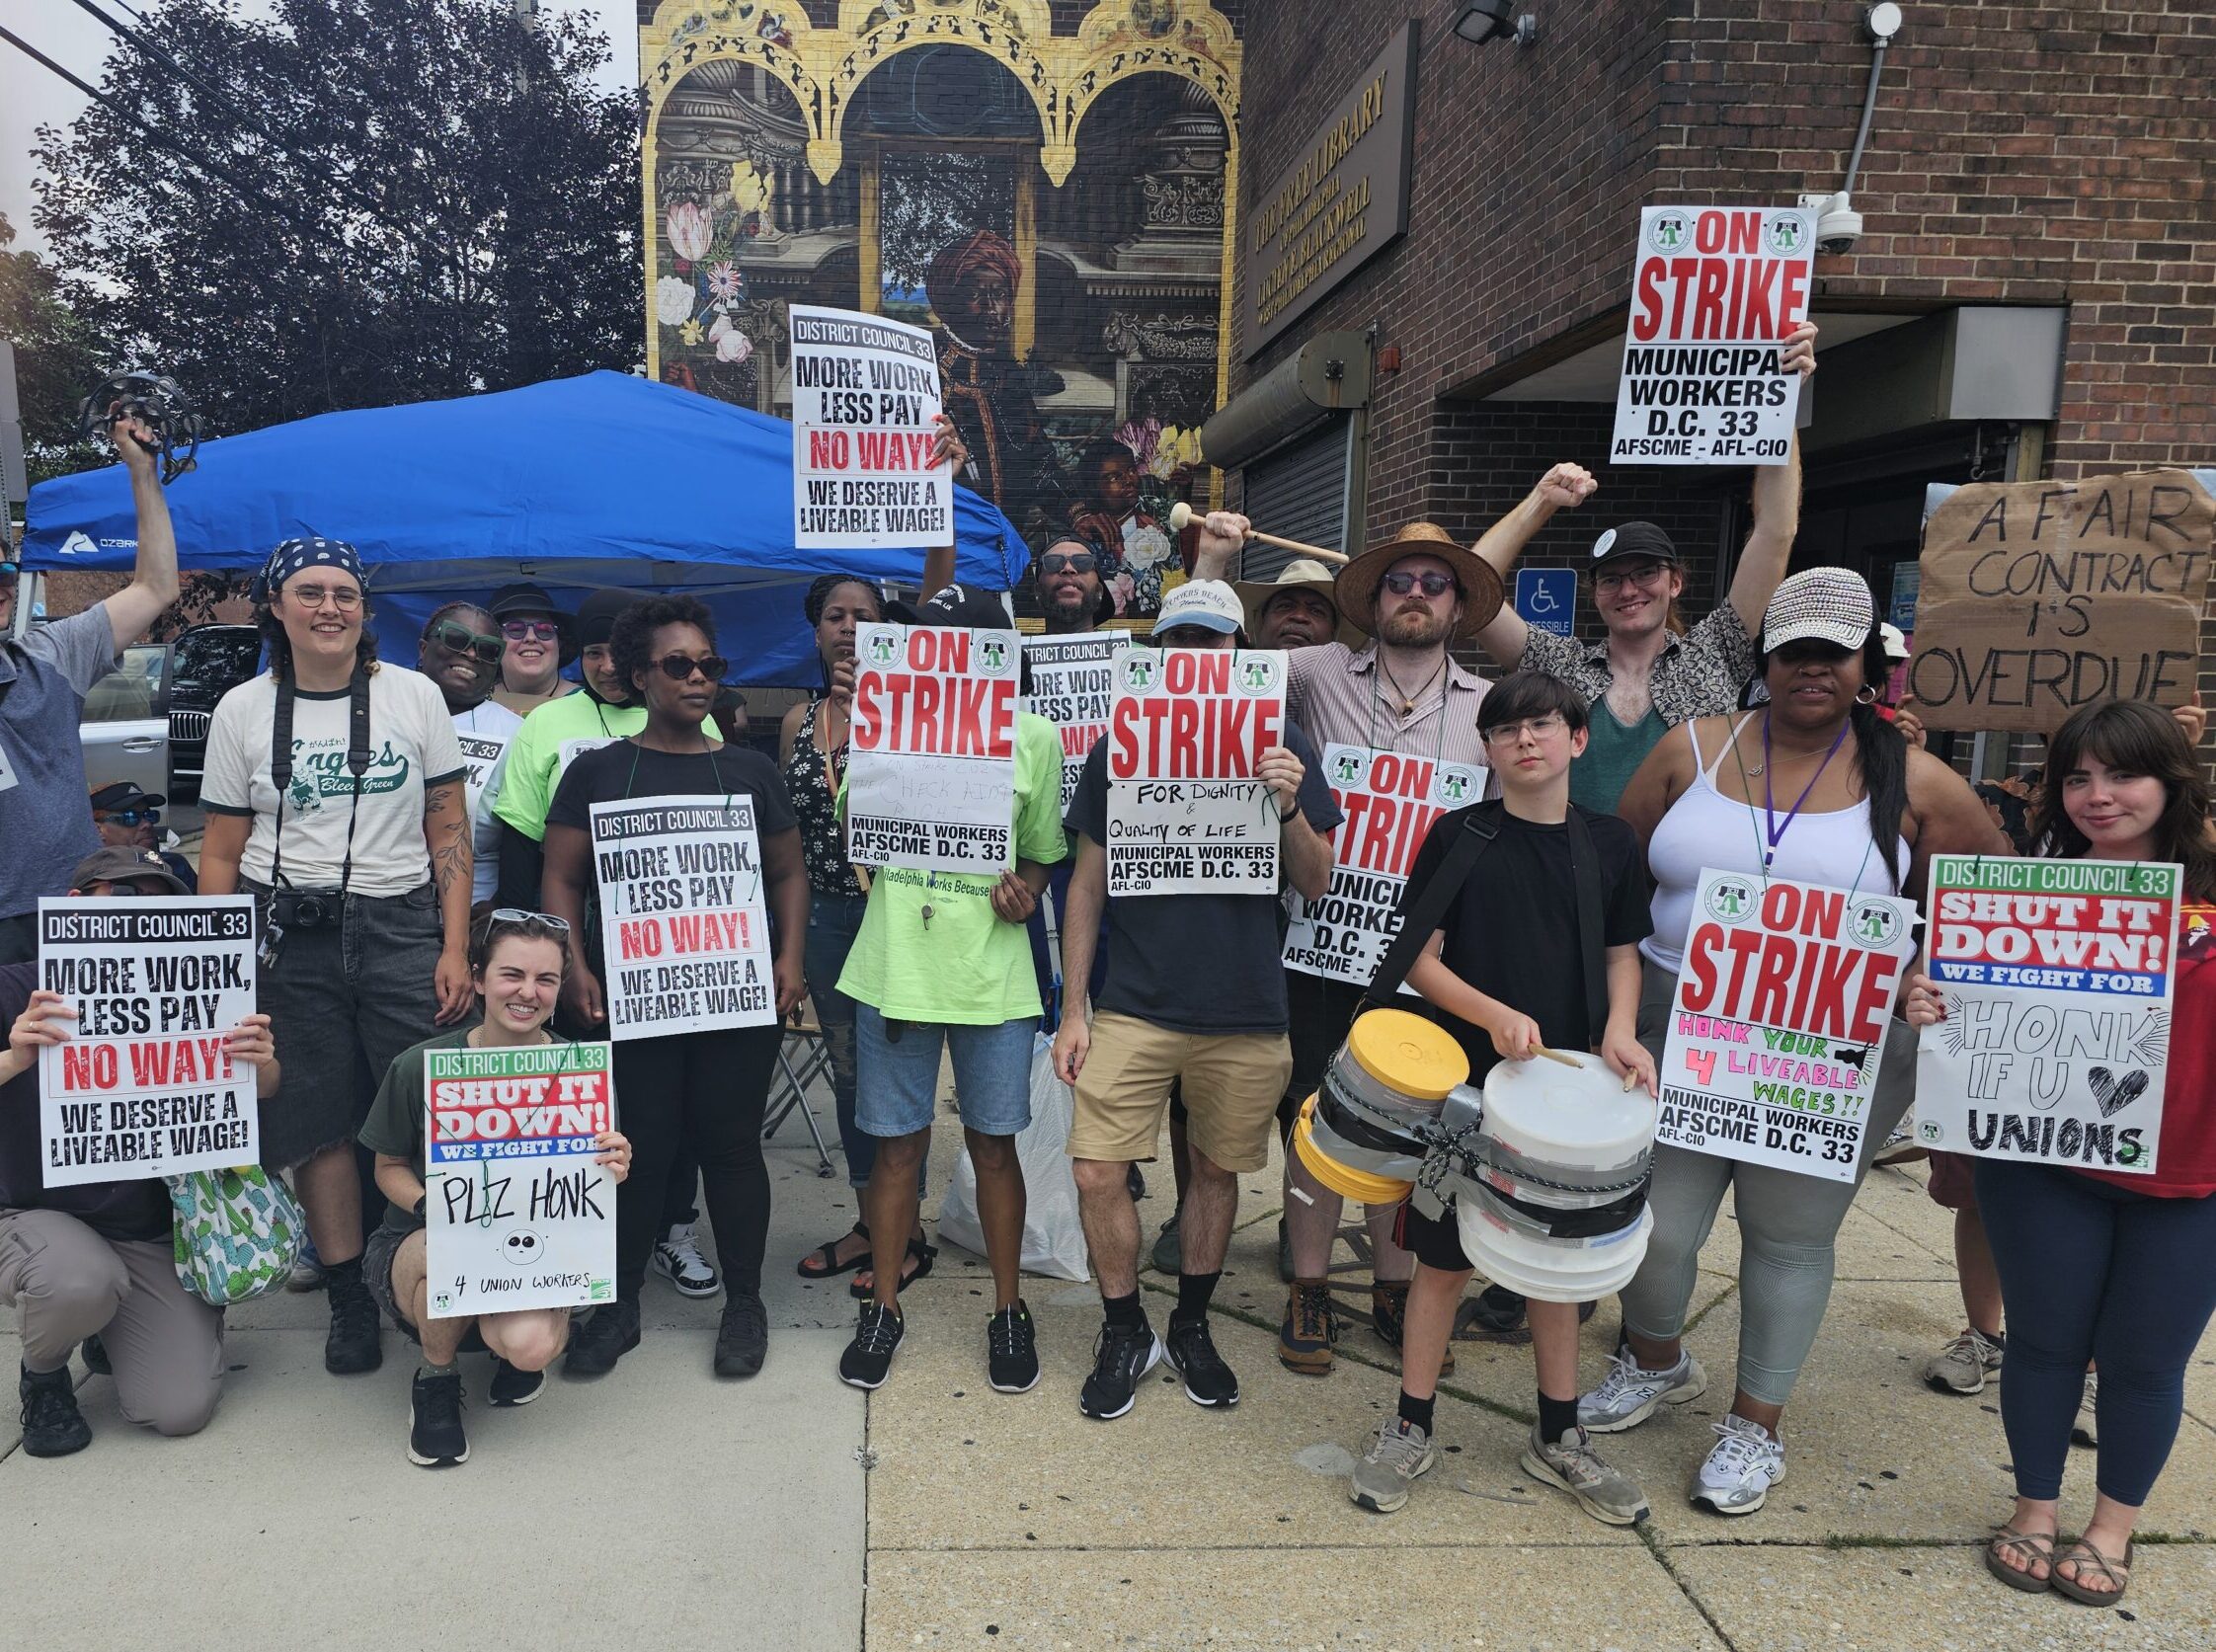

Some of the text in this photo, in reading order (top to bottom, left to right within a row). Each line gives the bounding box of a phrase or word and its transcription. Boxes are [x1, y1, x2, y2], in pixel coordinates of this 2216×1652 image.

[1255, 201, 1278, 253] THE
[1313, 69, 1388, 187] LIBRARY
[1696, 210, 1762, 254] ON
[1633, 257, 1808, 341] STRIKE
[797, 321, 931, 358] DISTRICT COUNCIL 33
[796, 355, 939, 402] MORE WORK,
[1630, 380, 1787, 406] WORKERS
[821, 392, 922, 425] LESS PAY
[1648, 410, 1759, 436] D.C. 33
[810, 431, 848, 469] NO
[1615, 439, 1787, 456] AFSCME AFL-CIO
[808, 480, 937, 506] WE DESERVE A
[801, 508, 944, 533] LIVEABLE WAGE!
[1968, 486, 2193, 543] A FAIR
[1968, 550, 2207, 597] CONTRACT
[2027, 594, 2093, 637] IS
[908, 629, 970, 673] ON
[1064, 644, 1109, 660] COUNCIL
[1032, 672, 1064, 697] ORE
[1165, 653, 1231, 694] ON
[855, 671, 1016, 758] STRIKE
[478, 745, 498, 757] 33
[1111, 697, 1280, 778] STRIKE
[363, 777, 393, 793] Green
[1138, 783, 1184, 804] FOR
[1369, 754, 1434, 800] ON
[599, 810, 750, 836] DISTRICT COUNCIL 33
[852, 818, 1007, 841] MUNICIPAL WORKERS
[1177, 826, 1196, 837] OF
[1206, 824, 1246, 837] LIFE
[599, 841, 757, 883] MORE WORK,
[851, 831, 1005, 861] AFSCME D.C. 33
[851, 849, 890, 861] AFL-CIO
[1111, 846, 1275, 860] MUNICIPAL WORKERS
[954, 880, 989, 897] Because
[1111, 861, 1273, 880] AFSCME D.C. 33
[1111, 880, 1150, 891] AFL-CIO
[1942, 861, 2169, 894] DISTRICT COUNCIL 33
[628, 876, 735, 913] LESS PAY
[1761, 884, 1845, 940] ON
[1939, 892, 2088, 925] SHUT
[2098, 900, 2160, 930] IT
[49, 914, 247, 938] DISTRICT COUNCIL 33
[620, 911, 750, 960] NO WAY!
[1303, 898, 1405, 935] WORKE
[1284, 947, 1352, 975] AFSCME
[1313, 925, 1396, 963] D.C. 3
[1938, 924, 2165, 972] DOWN!
[45, 954, 251, 995] MORE WORK,
[621, 959, 758, 996] WE DESERVE A
[1681, 922, 1898, 1044] STRIKE
[1940, 963, 2153, 992] WE FIGHT FOR
[78, 994, 219, 1036] LESS PAY
[615, 985, 767, 1025] LIVEABLE WAGE!
[1679, 1014, 1828, 1059] HONK YOUR
[1963, 1000, 2159, 1066] HONK
[63, 1038, 232, 1090] NO WAY!
[435, 1049, 604, 1076] DISTRICT COUNCIL 33
[1686, 1049, 1859, 1089] 4 LIVEABLE
[1968, 1053, 2069, 1110] IF U
[435, 1074, 600, 1110] SHUT IT
[60, 1091, 238, 1134] WE DESERVE A
[436, 1102, 605, 1141] DOWN!
[1663, 1088, 1859, 1141] MUNICIPAL WORKERS
[51, 1120, 247, 1167] LIVEABLE WAGE!
[440, 1144, 477, 1160] WE
[482, 1141, 552, 1158] FIGHT
[1658, 1127, 1704, 1146] AFL-CIO
[1660, 1106, 1855, 1164] AFSCME D.C. 33
[1968, 1109, 2143, 1165] UNIONS
[443, 1167, 604, 1224] PLZ HONK
[455, 1272, 591, 1298] 4 UNION WORKERS
